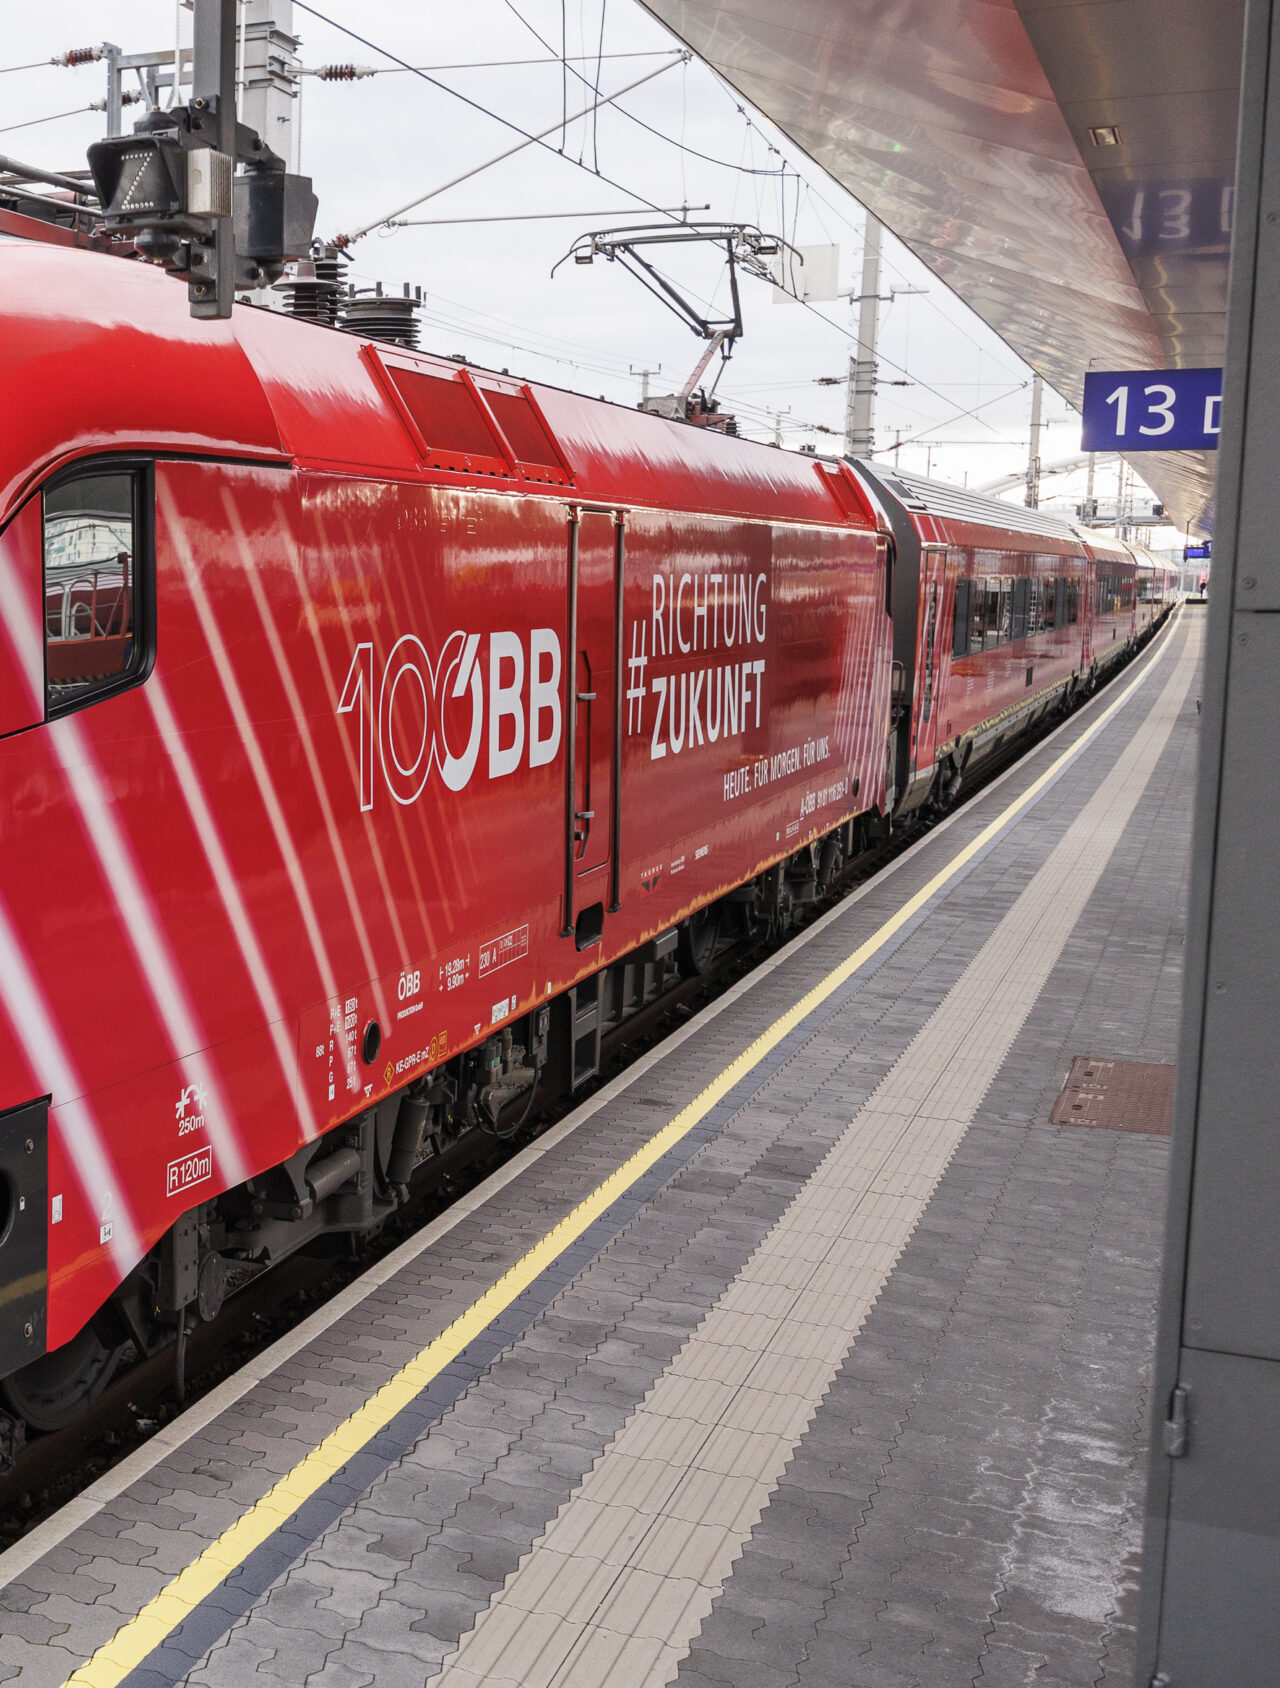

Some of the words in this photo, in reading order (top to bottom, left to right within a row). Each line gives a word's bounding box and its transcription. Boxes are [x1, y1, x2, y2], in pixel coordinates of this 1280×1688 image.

[1105, 384, 1177, 436] 13
[652, 573, 767, 657] RICHTUNG
[650, 659, 766, 760] ZUKUNFT
[723, 765, 752, 802] HEUTE.
[754, 754, 769, 789] FÜR
[770, 746, 801, 782] MORGEN.
[803, 736, 816, 768] FÜR
[816, 735, 831, 762] UNS.
[398, 970, 421, 1001] ÖBB
[178, 1115, 205, 1136] 250m
